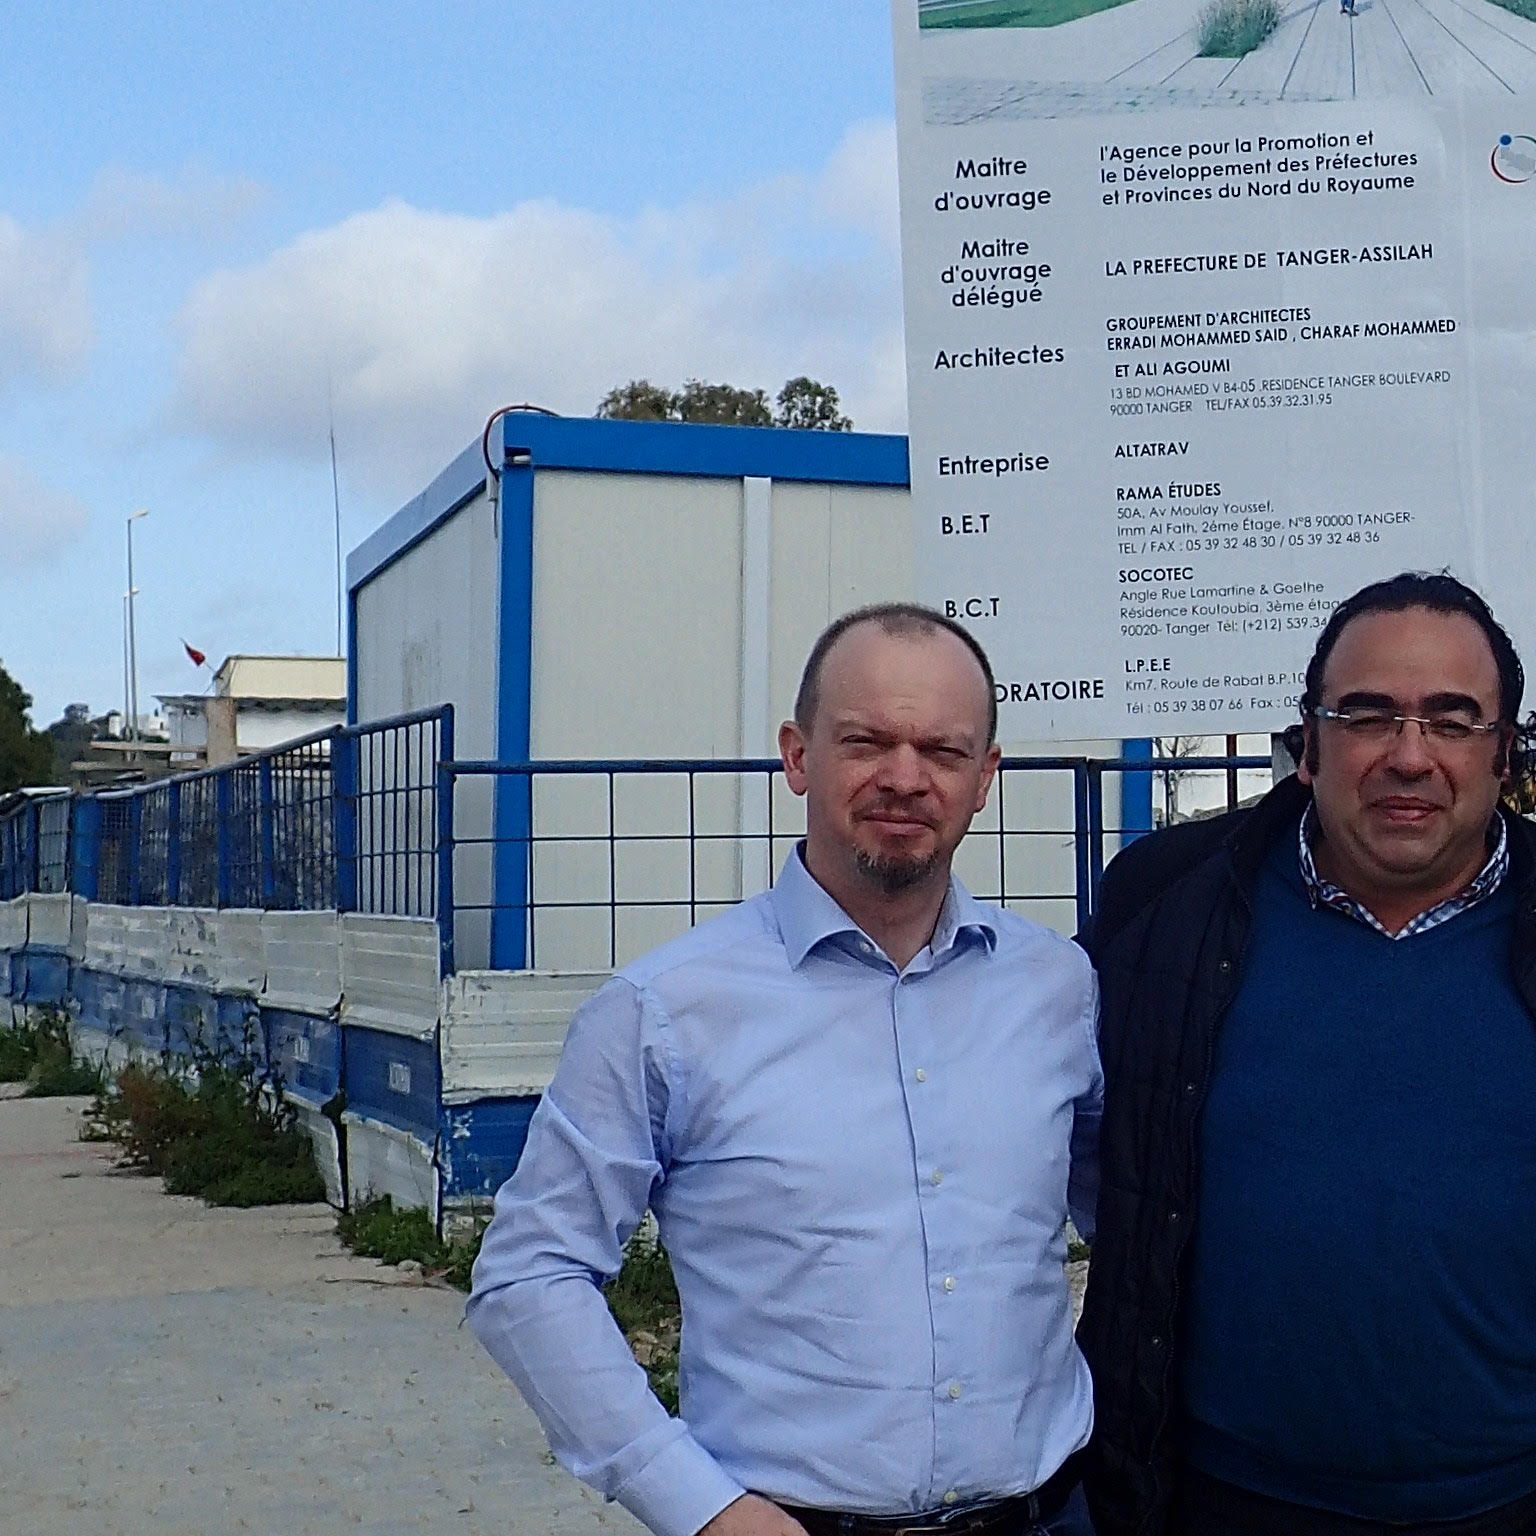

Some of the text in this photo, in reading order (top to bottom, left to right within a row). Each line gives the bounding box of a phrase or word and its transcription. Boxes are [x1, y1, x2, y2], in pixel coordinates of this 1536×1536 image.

[1100, 130, 1374, 164] l'Agence pour la Promotion et
[955, 156, 1027, 179] Maitre
[1100, 151, 1418, 184] le Développement des Préfectures
[934, 190, 1052, 212] d'ouvrage
[1102, 176, 1415, 206] et Provinces du Nord du Royaume
[961, 238, 1030, 260] Maitre
[1105, 243, 1433, 277] LA PREFECTURE DE TANGER-ASSILAH
[941, 264, 1052, 284] d'ouvrage
[951, 281, 1043, 309] délégué
[1106, 307, 1311, 332] GROUPEMENT D'ARCHITECTES
[1107, 319, 1456, 351] ERRADI MOHAMMED SAID CHARAF MOHAMMED
[934, 344, 1065, 370] Architectes
[1115, 358, 1230, 378] ET ALI AGOUMI
[1111, 387, 1123, 400] 13
[1125, 386, 1142, 399] BD
[1145, 383, 1209, 397] MOHAMED
[1212, 383, 1220, 394] V
[1328, 374, 1376, 388] TANGER
[1379, 370, 1451, 386] BOULEVARD
[1110, 402, 1144, 417] 90000
[1146, 400, 1193, 414] TANGER
[1205, 397, 1250, 411] TEL/FAX
[1114, 441, 1189, 458] ALTATRAV
[939, 452, 1050, 478] Entreprise
[1116, 480, 1222, 501] RAMA ÉTUDES
[1149, 504, 1219, 518] Av Moulay
[941, 513, 991, 535] B.E.T
[1117, 525, 1146, 537] Imm
[1150, 523, 1163, 536] Al
[1315, 514, 1354, 528] 90000
[1118, 530, 1380, 555] TEL FAX 05 39 32 48 30 05 39 32 48 36
[1118, 566, 1194, 584] SOCOTEC
[1119, 581, 1325, 604] Angle Rue Lamartine Goethe
[944, 597, 1000, 618] B.C.T
[1120, 606, 1188, 619] Résidence
[1165, 623, 1210, 637] Tanger
[1242, 618, 1282, 633] (+212)
[1125, 657, 1171, 673] L.P.E.E
[995, 679, 1104, 703] ORATOIRE
[1160, 674, 1264, 690] Route de Rabat
[1126, 695, 1300, 714] Tél 05 39 38 07 66 Fax 05
